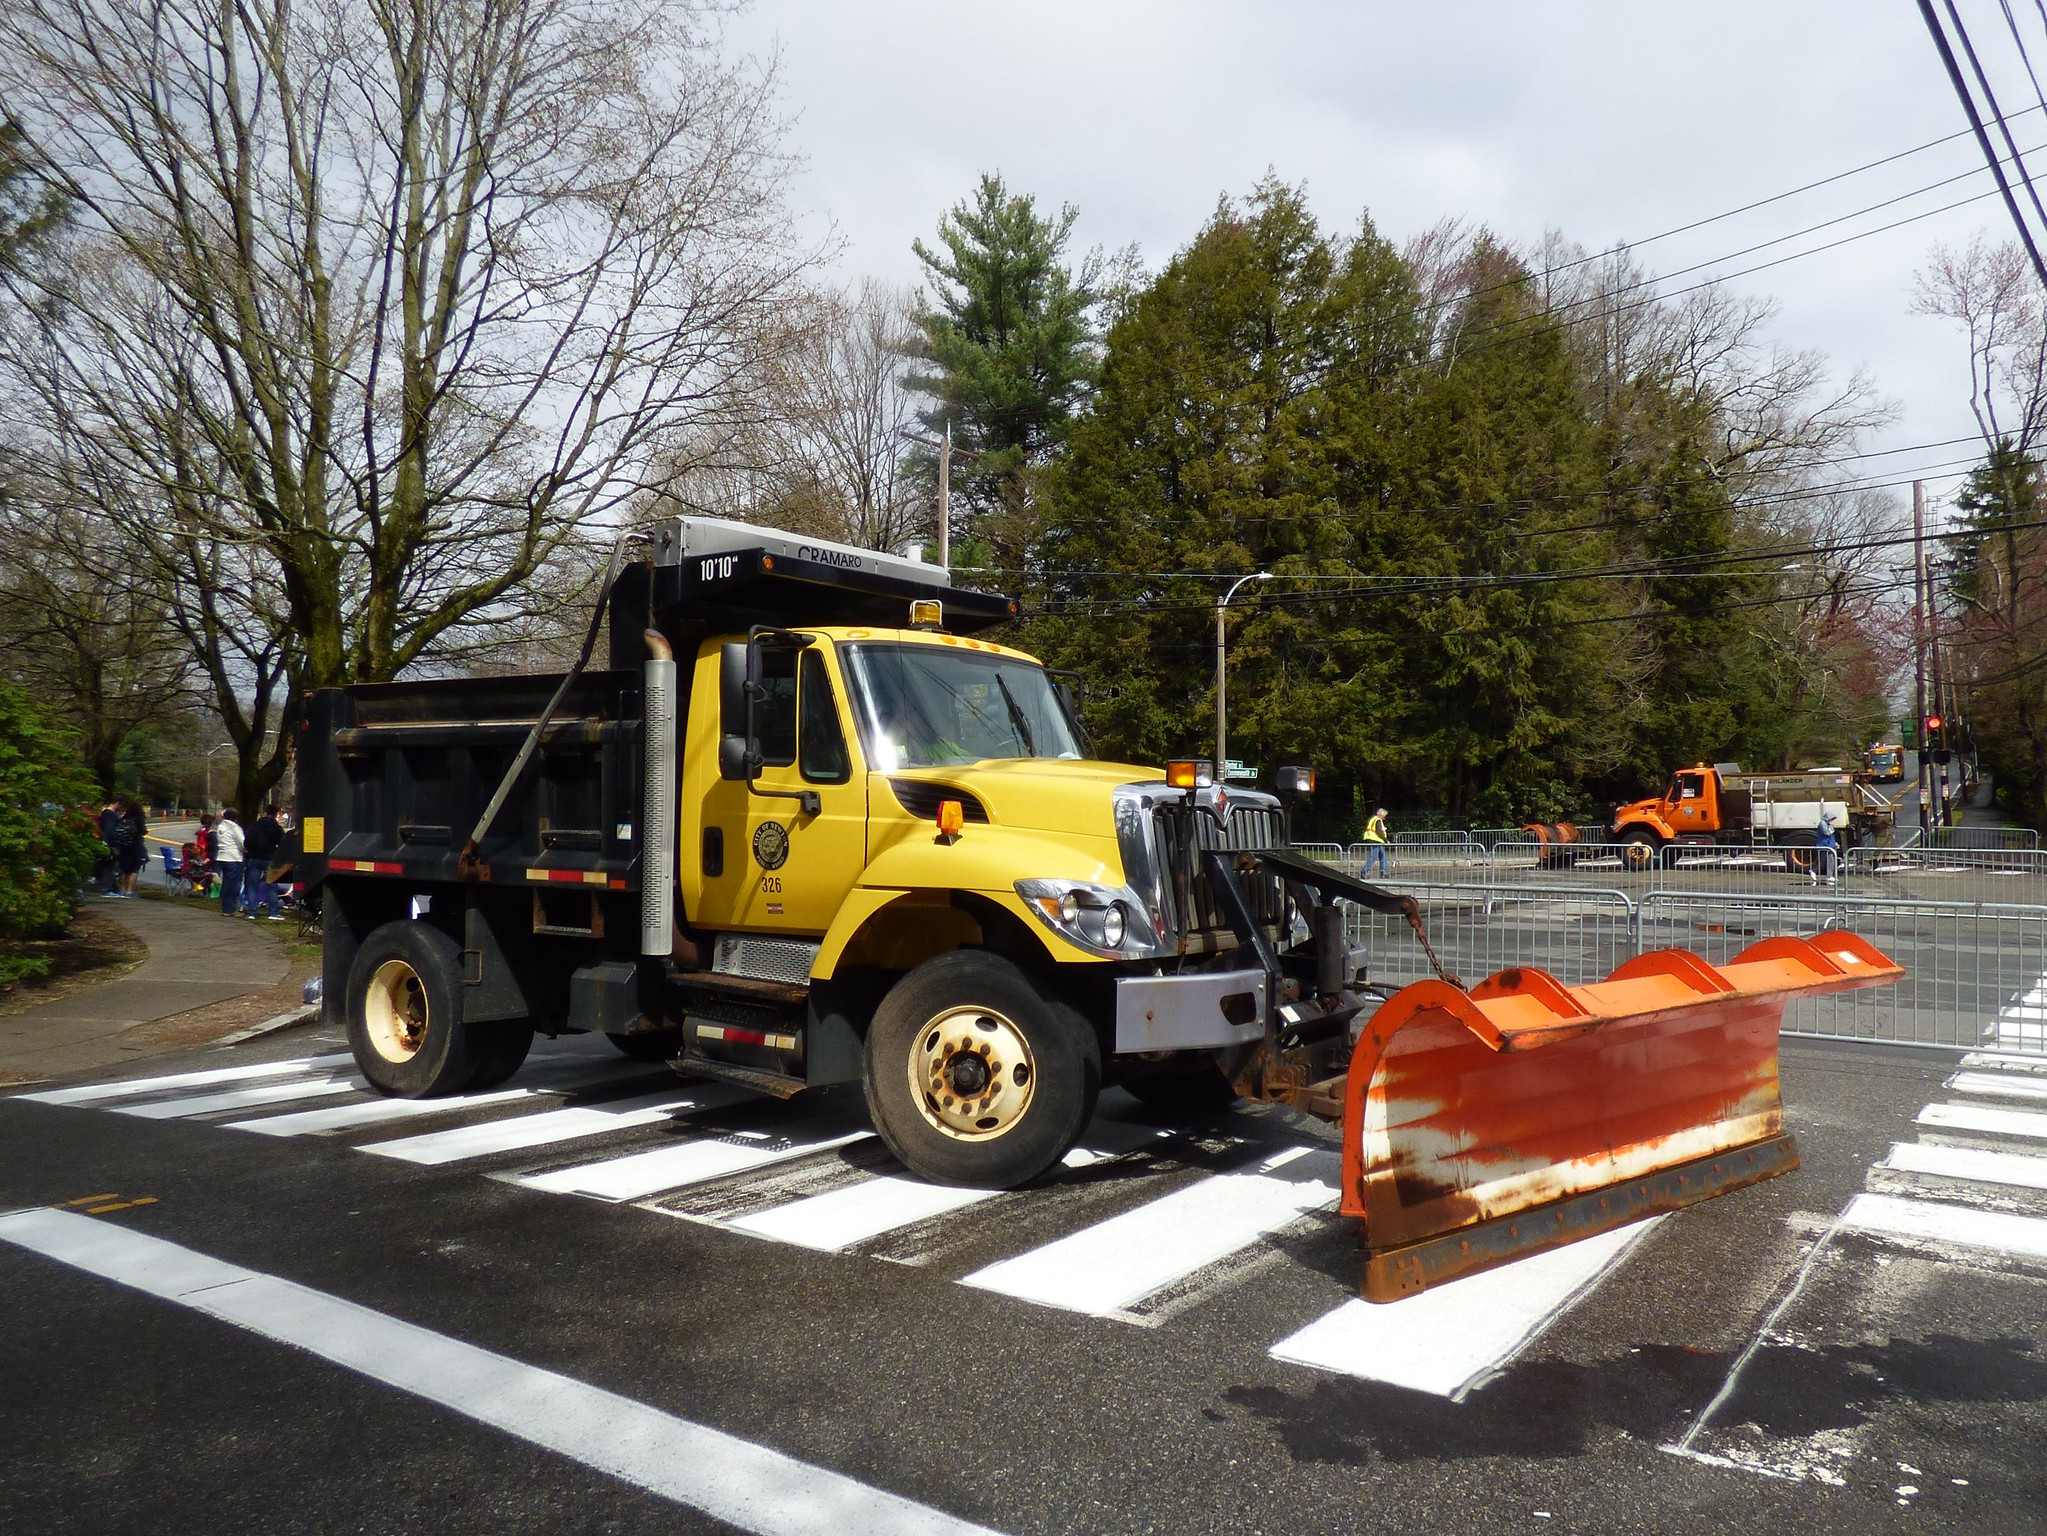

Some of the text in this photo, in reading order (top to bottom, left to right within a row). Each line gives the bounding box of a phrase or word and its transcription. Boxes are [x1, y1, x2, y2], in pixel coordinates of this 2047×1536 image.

[798, 546, 862, 568] CRAMARO
[753, 822, 788, 847] CITY OF NEWTON
[761, 877, 782, 893] 326
